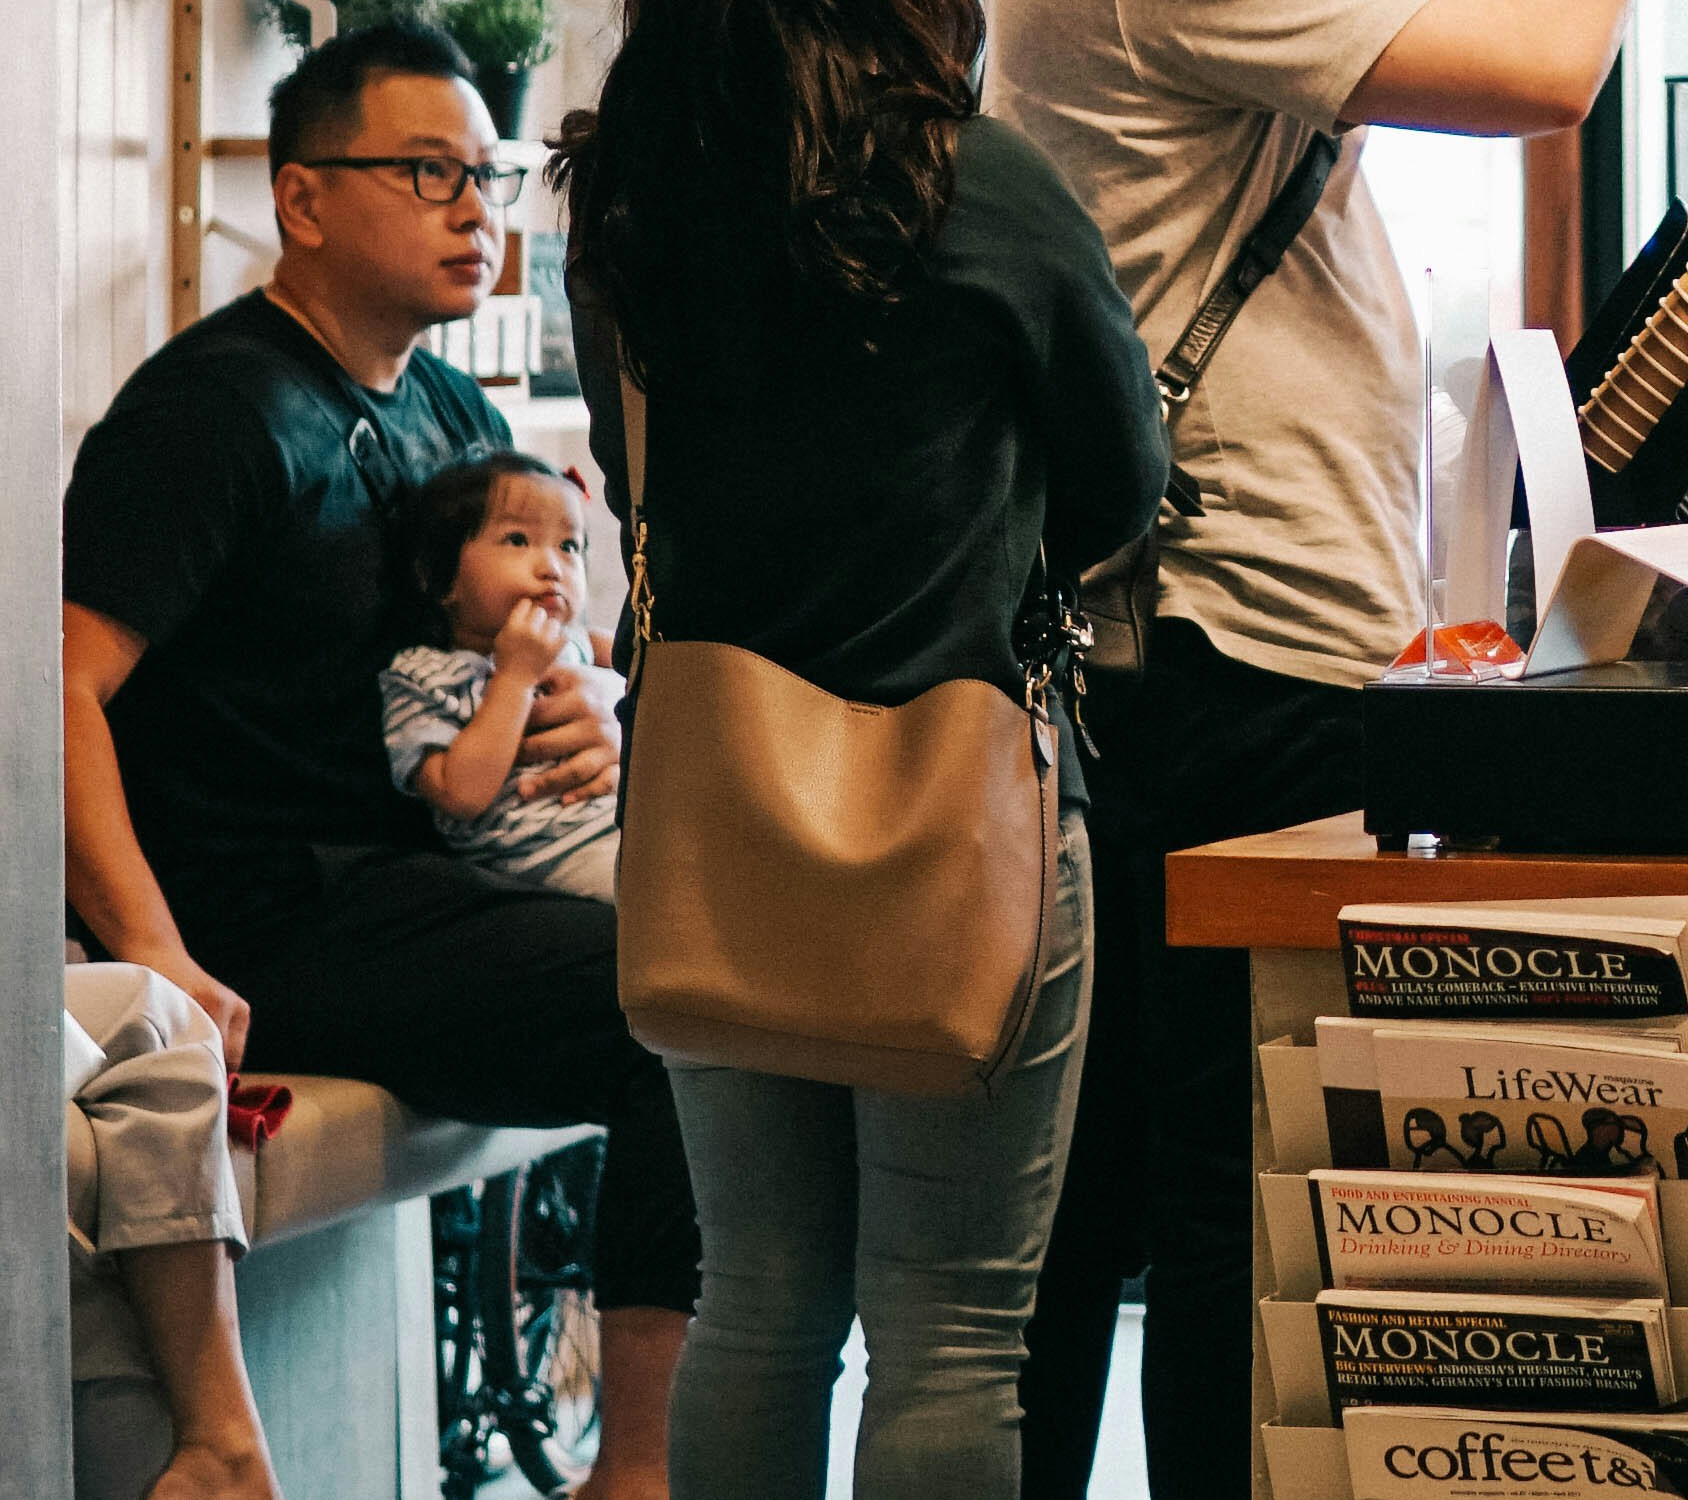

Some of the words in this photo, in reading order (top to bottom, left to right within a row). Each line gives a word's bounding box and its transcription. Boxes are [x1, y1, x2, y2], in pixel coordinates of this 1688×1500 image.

[1353, 944, 1632, 980] MONOCLE
[1392, 982, 1434, 993] LULA'S
[1437, 982, 1505, 993] COMEBACK
[1519, 981, 1586, 993] EXCLUSIVE
[1358, 993, 1382, 1005] AND
[1386, 995, 1405, 1006] WE
[1407, 994, 1441, 1006] NAME
[1445, 994, 1471, 1005] OUR
[1472, 994, 1529, 1005] WINNING
[1613, 995, 1658, 1006] NATION
[1460, 1066, 1663, 1107] LifeWear
[1331, 1187, 1363, 1200] FOOD
[1367, 1191, 1389, 1200] AND
[1393, 1191, 1481, 1204] ENTERTAINING
[1485, 1196, 1530, 1208] ANNUAL
[1336, 1202, 1612, 1244] MONOCLE
[1341, 1238, 1430, 1257] Drinking
[1438, 1239, 1460, 1255] &
[1464, 1239, 1534, 1260] Dining
[1541, 1241, 1631, 1264] Directory
[1328, 1310, 1378, 1324] FASHION
[1381, 1315, 1405, 1326] AND
[1408, 1316, 1452, 1327] RETAIL
[1456, 1317, 1507, 1328] SPECIAL
[1332, 1324, 1609, 1364] MONOCLE
[1336, 1360, 1355, 1372] BIG
[1439, 1363, 1515, 1376] INDONESIA'S
[1518, 1365, 1590, 1377] PRESIDENT,
[1592, 1367, 1643, 1379] APPLE'S
[1338, 1374, 1381, 1385] RETAIL
[1383, 1376, 1429, 1387] MAVEN,
[1432, 1377, 1502, 1388] GERMANY'S
[1506, 1377, 1535, 1387] CULT
[1540, 1377, 1592, 1388] FASHION
[1595, 1378, 1637, 1390] BRAND
